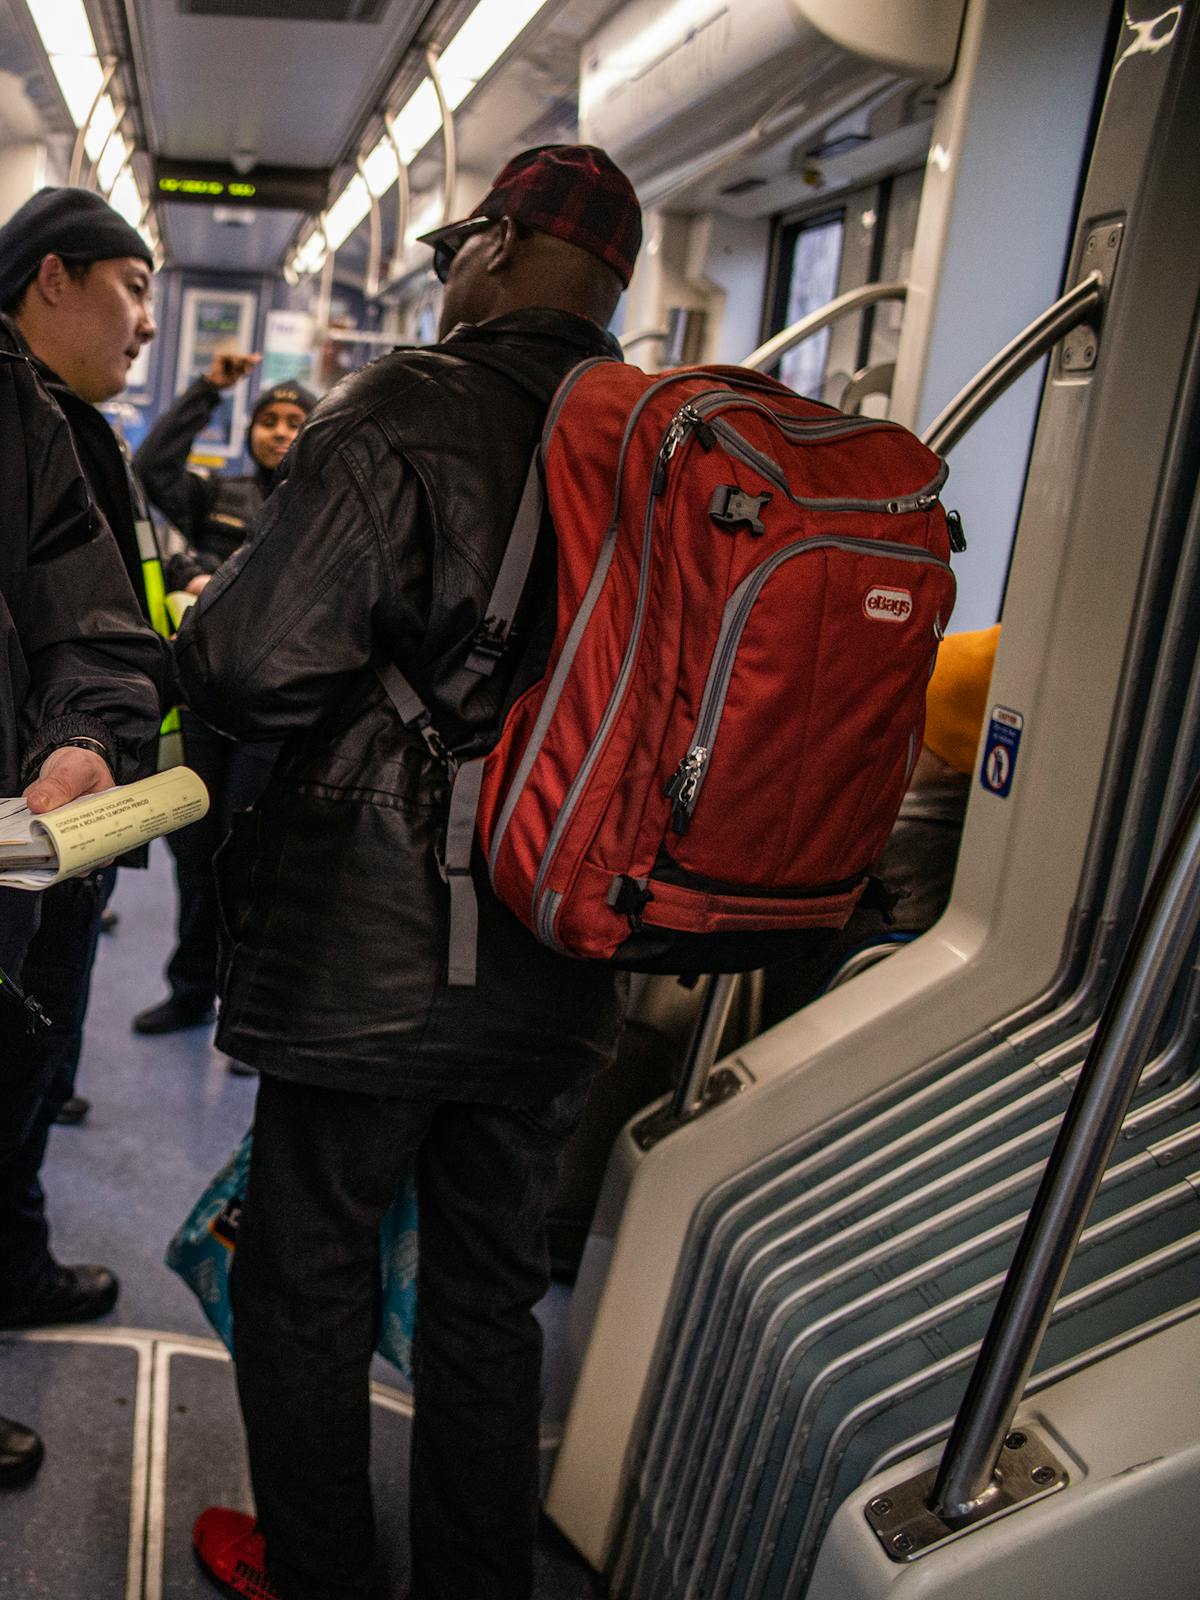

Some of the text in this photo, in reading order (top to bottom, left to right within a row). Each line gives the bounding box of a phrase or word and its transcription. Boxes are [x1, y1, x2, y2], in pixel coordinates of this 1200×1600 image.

[868, 595, 910, 616] eBags
[105, 797, 135, 810] VIOLATIONS
[130, 798, 150, 809] PERIOD
